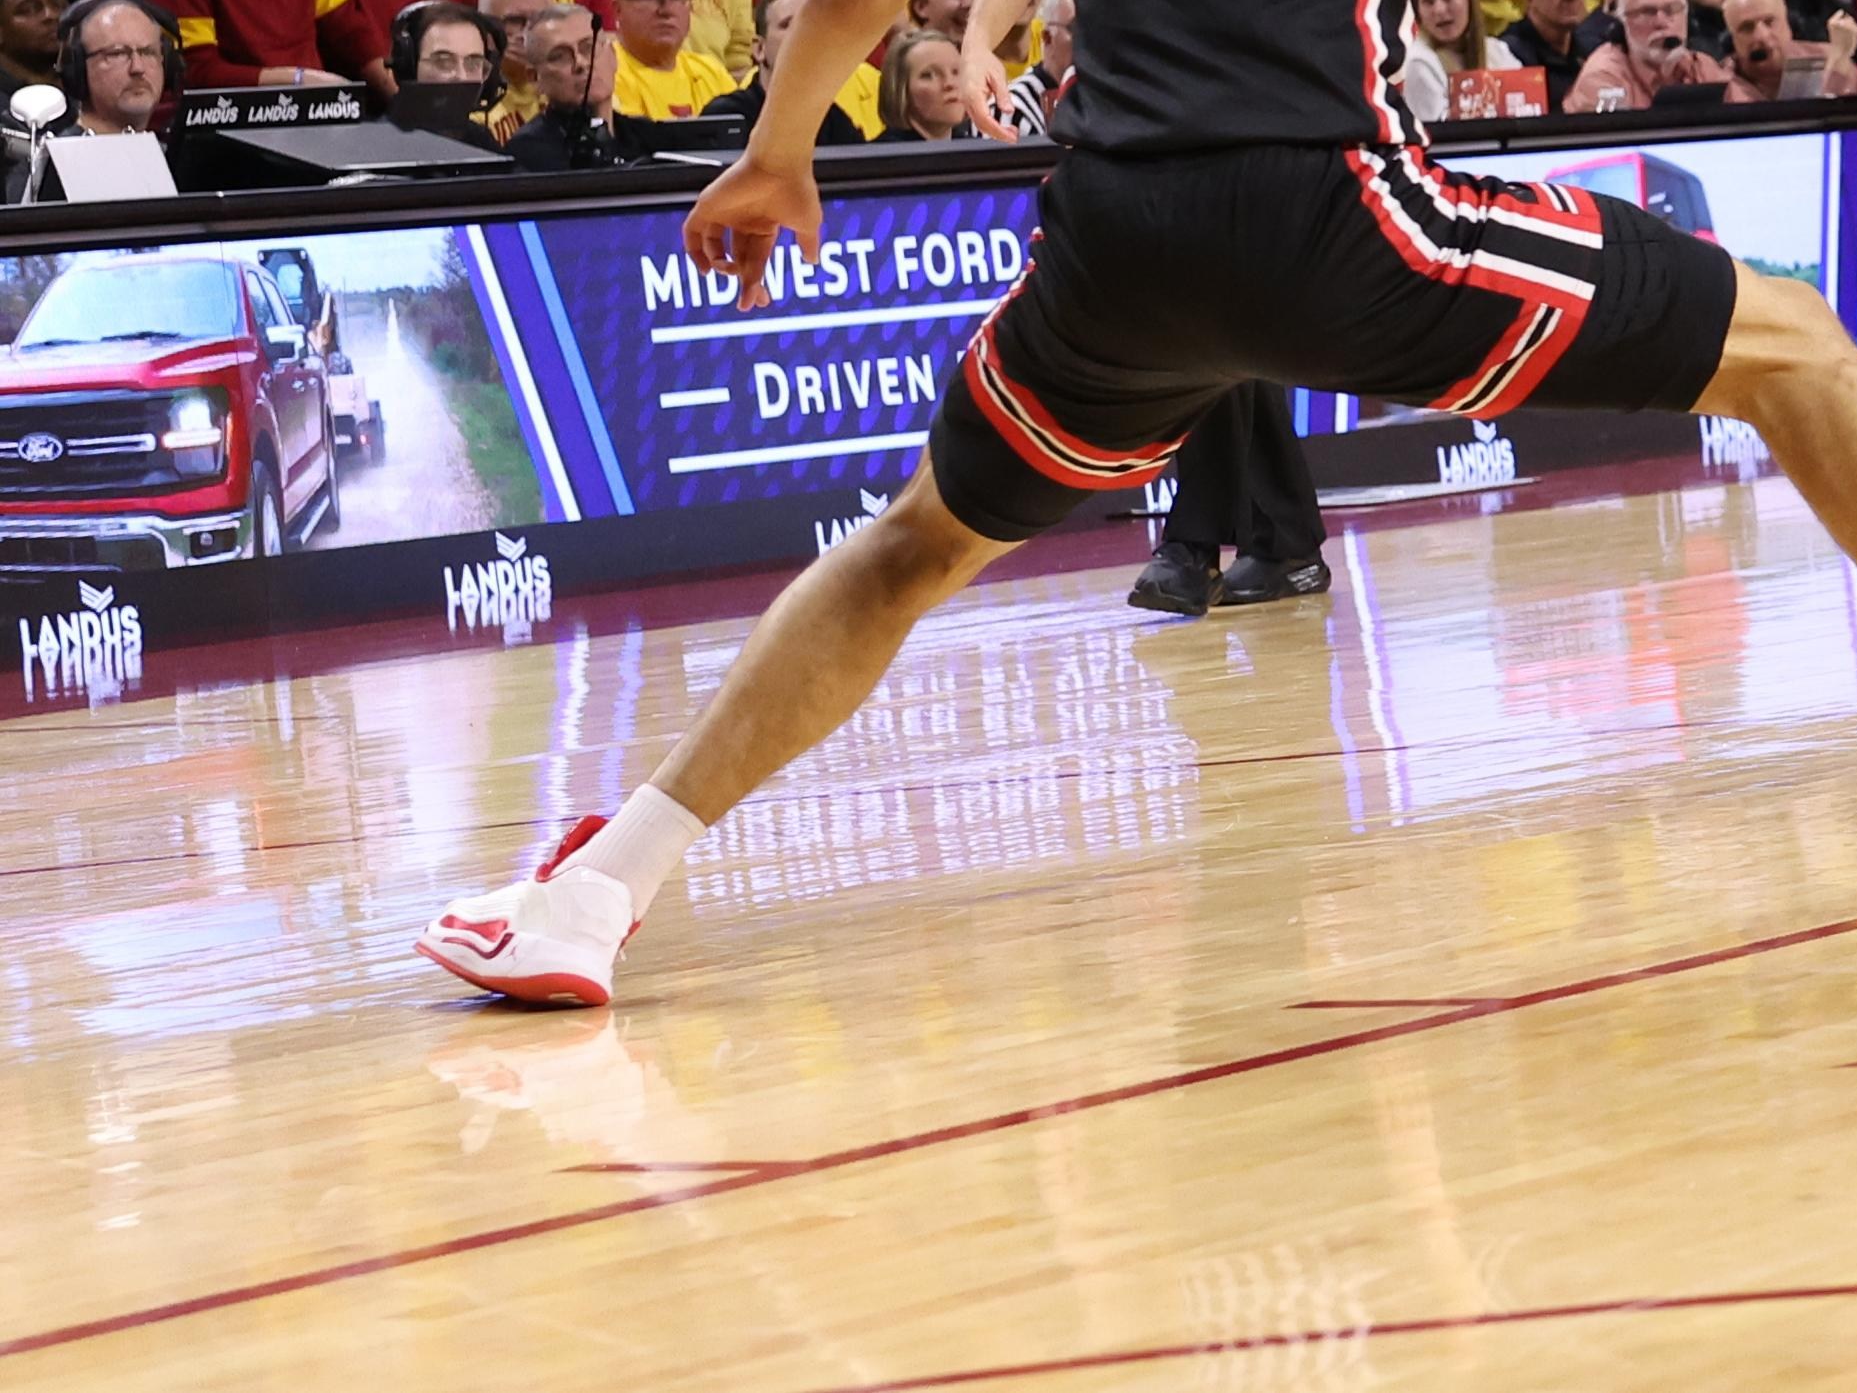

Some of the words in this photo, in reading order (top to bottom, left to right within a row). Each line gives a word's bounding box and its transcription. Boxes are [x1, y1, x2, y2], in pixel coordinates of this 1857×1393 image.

[186, 106, 239, 126] LANDUS
[248, 103, 299, 123] LANDUS
[308, 101, 360, 120] LANDUS
[894, 228, 1023, 290] FORD
[753, 354, 937, 419] DRIVEN
[1437, 437, 1515, 471] LANDUS
[443, 554, 551, 606] LANDUS
[19, 605, 142, 656] LANDUS
